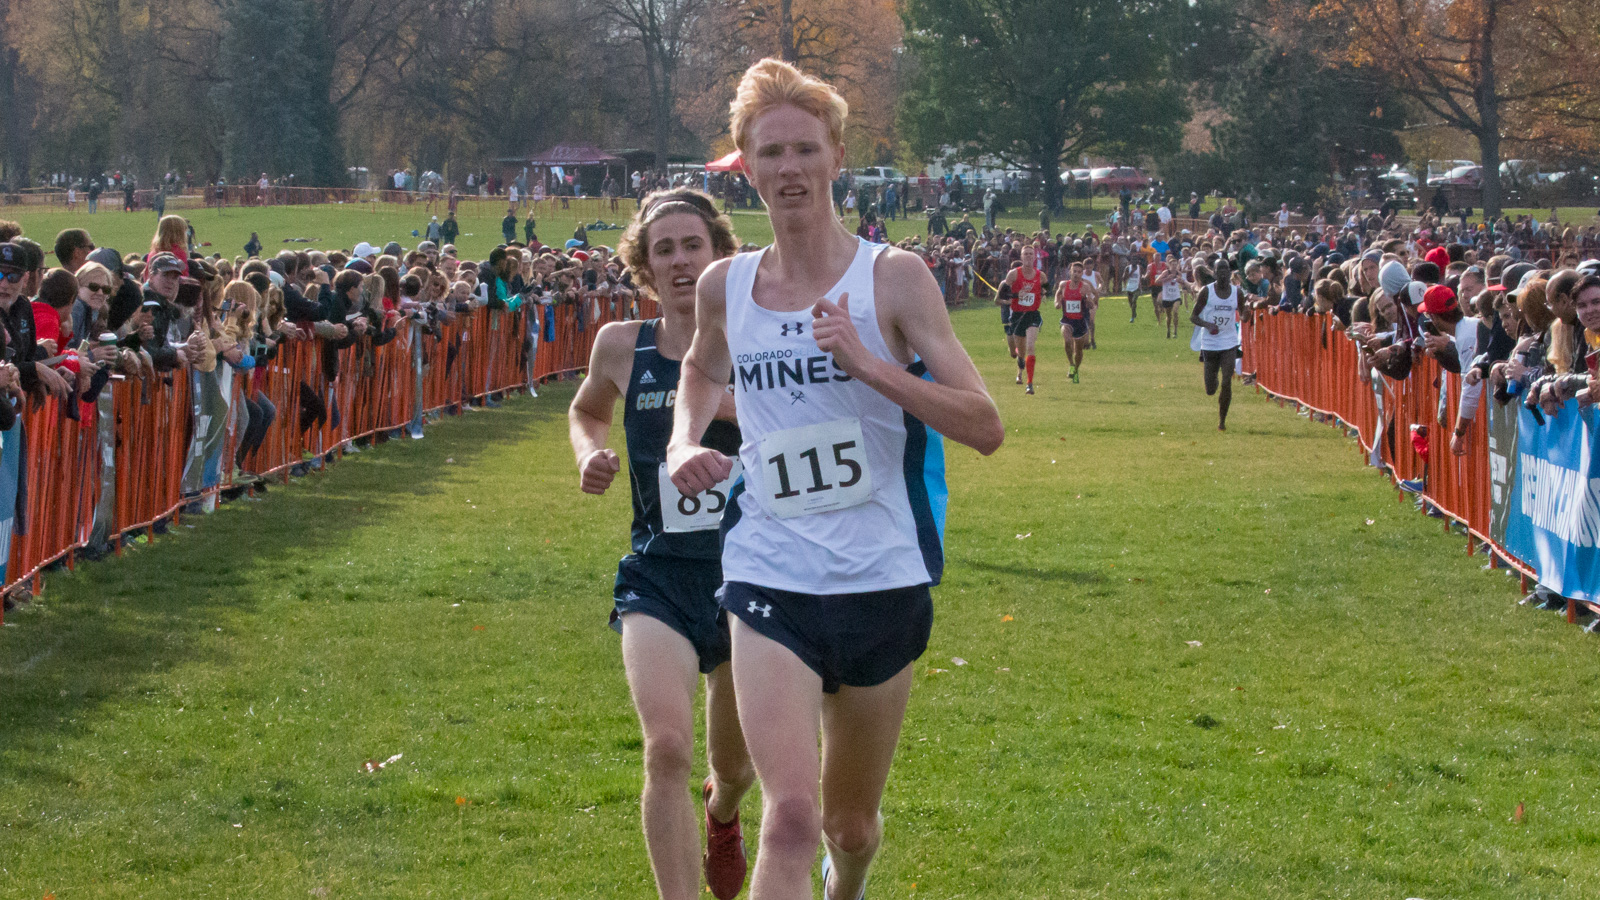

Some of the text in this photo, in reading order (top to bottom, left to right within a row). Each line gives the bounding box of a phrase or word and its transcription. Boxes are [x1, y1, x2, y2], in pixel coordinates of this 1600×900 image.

[1213, 315, 1230, 326] 397
[737, 349, 792, 363] COLORADO
[739, 356, 852, 392] MINES
[636, 391, 665, 411] CCU
[768, 440, 862, 500] 115
[677, 488, 727, 516] 85
